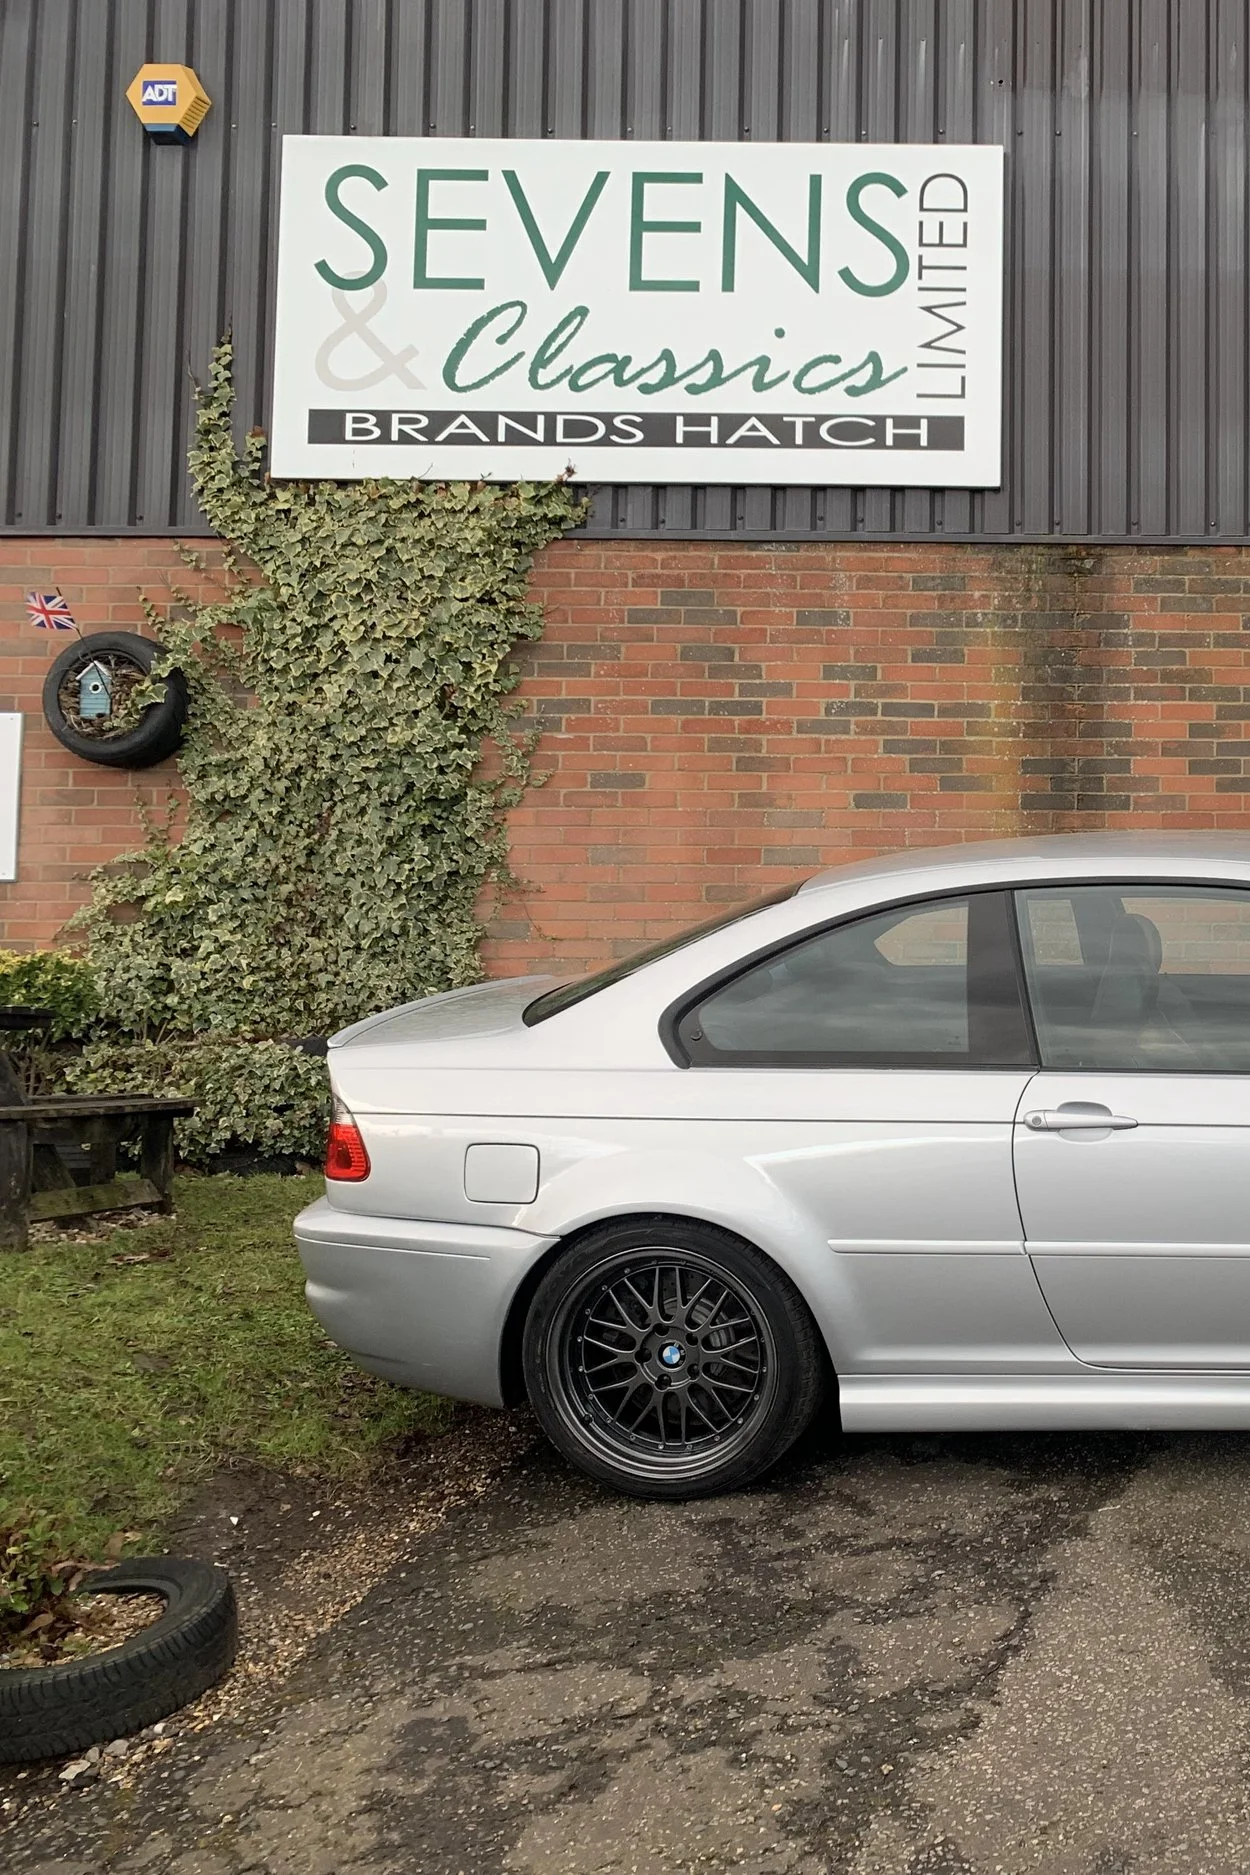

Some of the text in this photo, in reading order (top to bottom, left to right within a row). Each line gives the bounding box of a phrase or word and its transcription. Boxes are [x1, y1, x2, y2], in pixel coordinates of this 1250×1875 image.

[142, 84, 178, 102] ADT
[314, 164, 911, 298] SEVENS
[916, 173, 968, 399] LIMITED
[314, 271, 908, 398] & Classics
[344, 412, 929, 447] BRANDS HATCH
